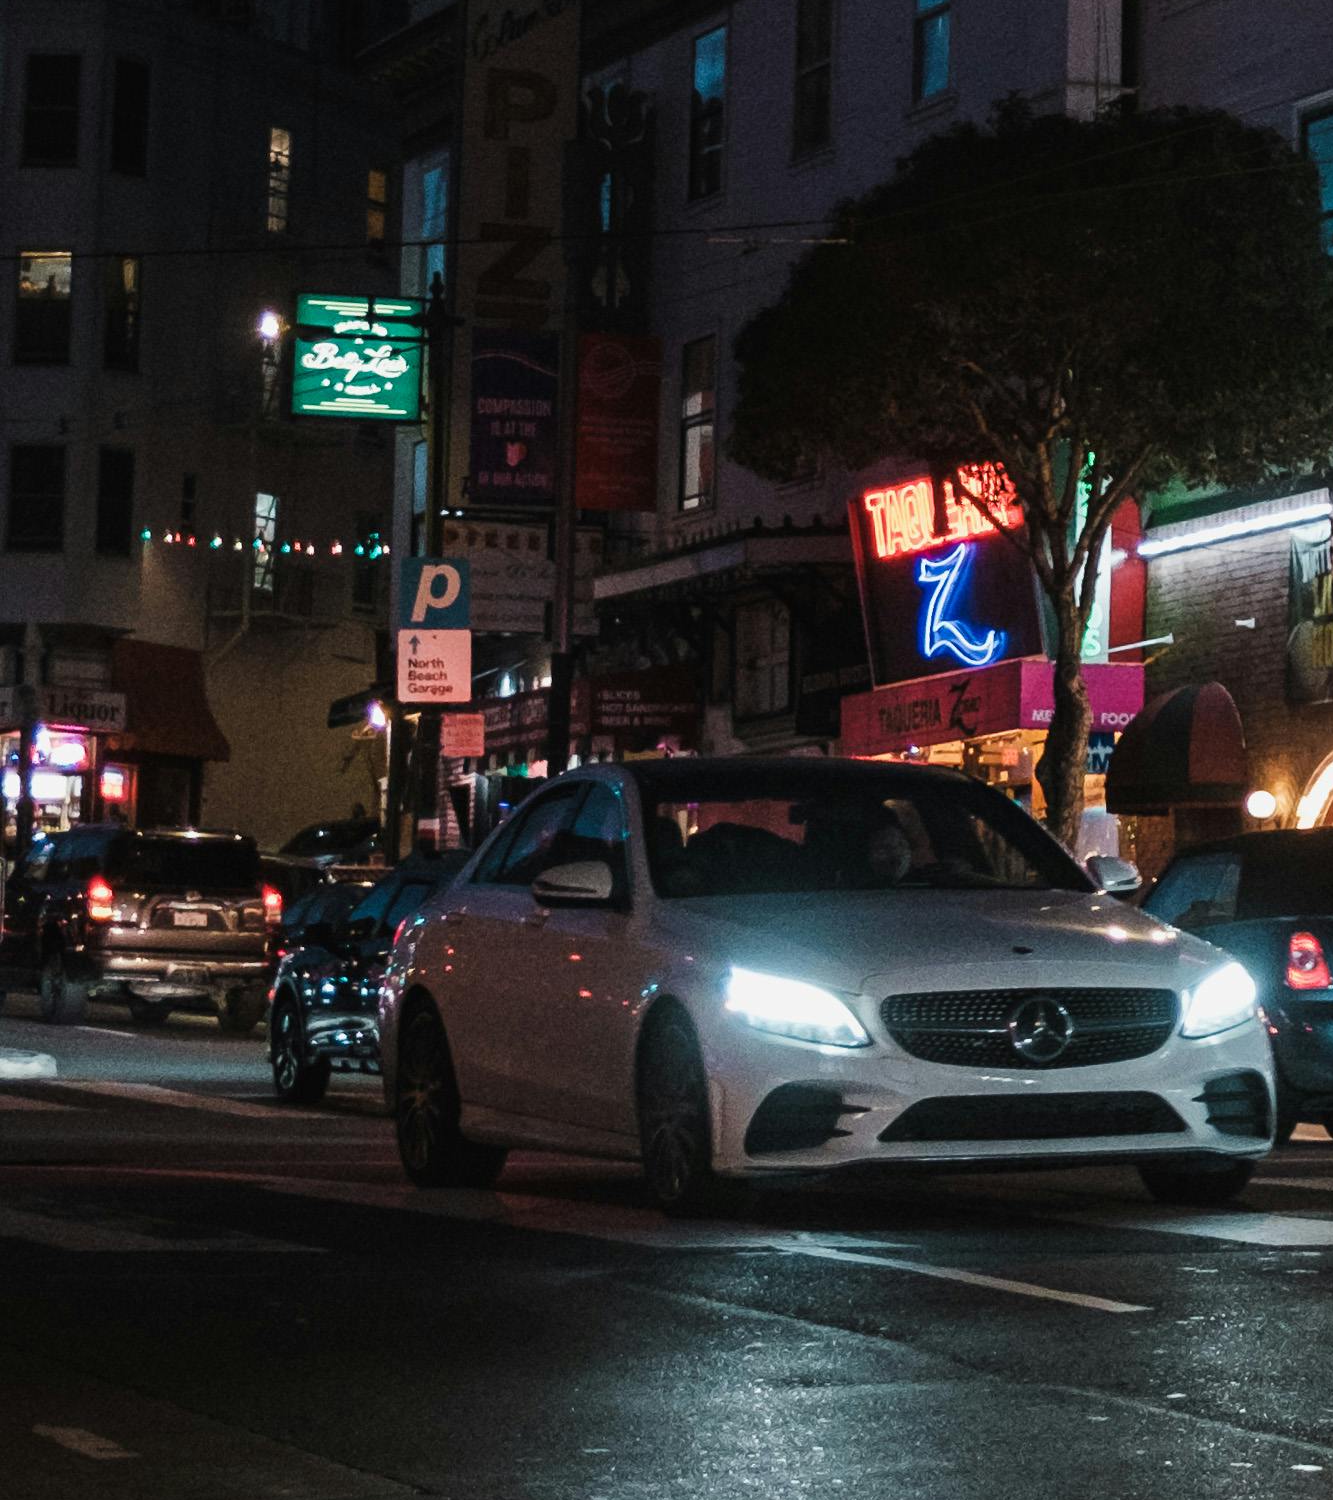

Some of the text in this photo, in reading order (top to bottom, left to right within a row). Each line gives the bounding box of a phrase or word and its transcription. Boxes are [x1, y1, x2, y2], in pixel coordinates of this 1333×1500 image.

[408, 658, 445, 669] North
[408, 670, 448, 681] Beach
[408, 683, 453, 696] Garage
[602, 689, 641, 700] SLICES
